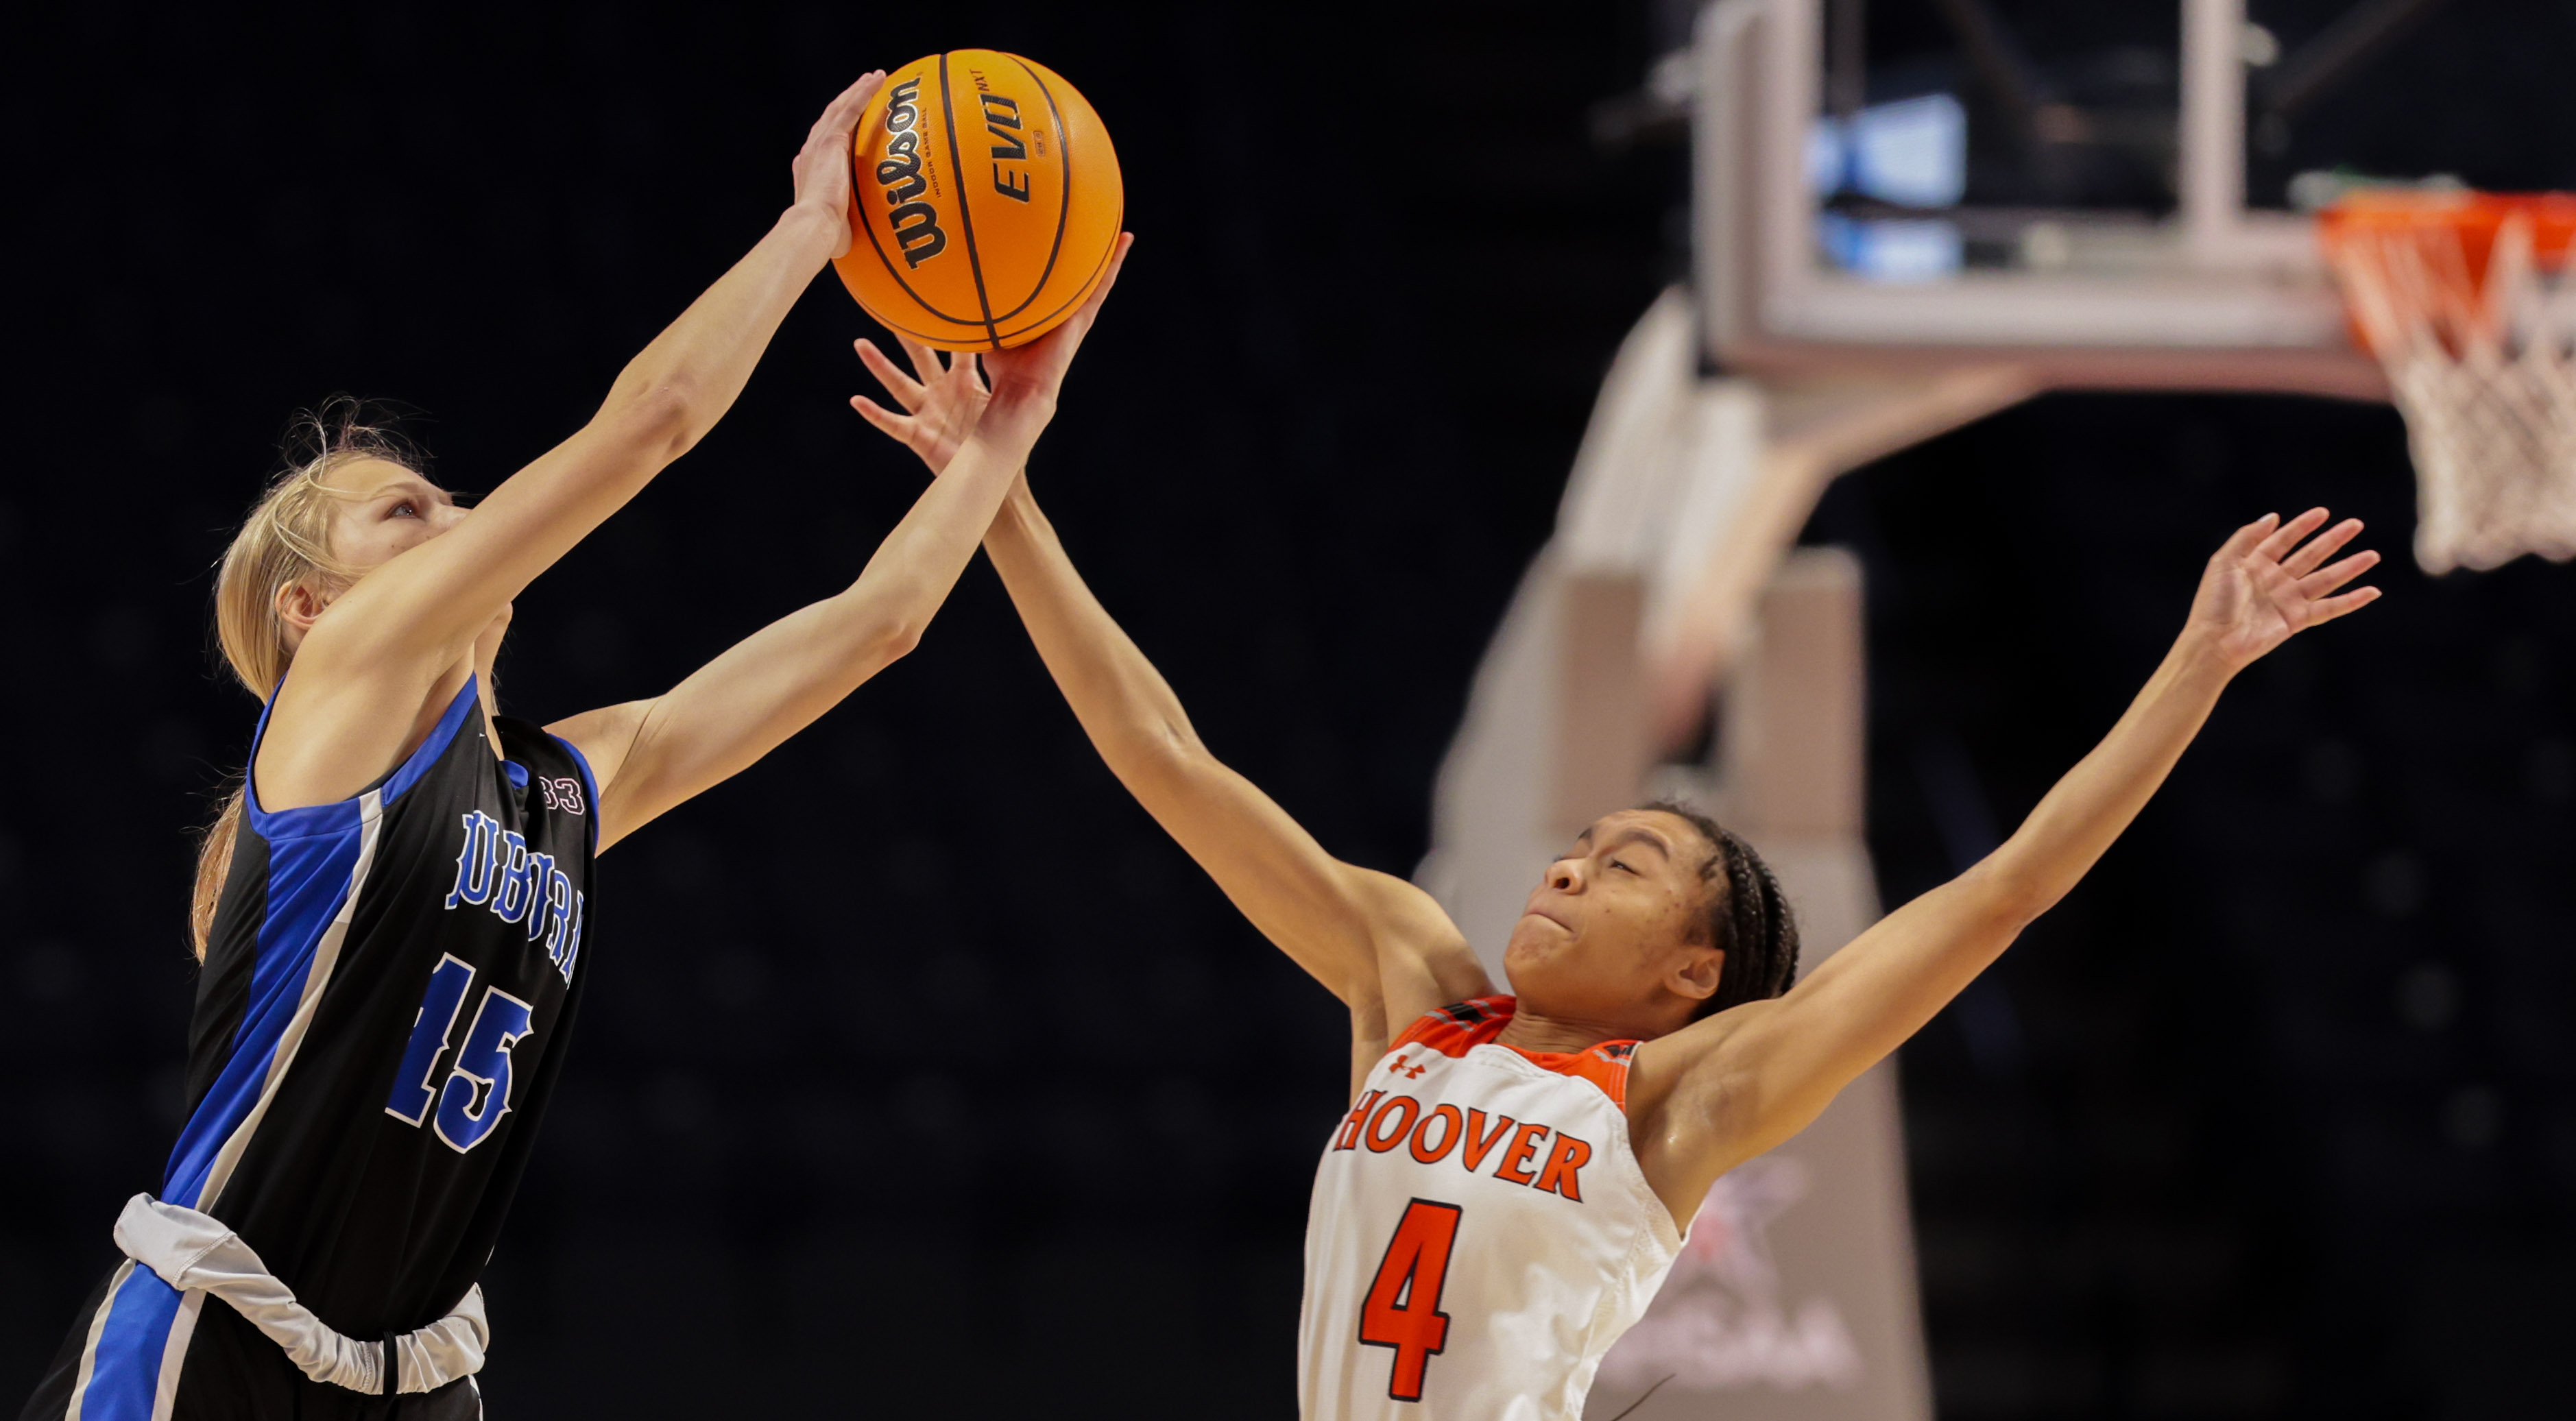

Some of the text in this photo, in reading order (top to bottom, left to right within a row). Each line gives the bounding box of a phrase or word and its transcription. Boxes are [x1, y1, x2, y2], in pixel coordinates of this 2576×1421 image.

[876, 77, 948, 270] Wilson
[922, 132, 931, 158] GAME
[928, 161, 941, 198] INDOOR
[970, 69, 1030, 204] EVO NXT
[385, 952, 534, 1154] 15
[1332, 1089, 1592, 1203] HOOVER
[1358, 1197, 1462, 1402] 4
